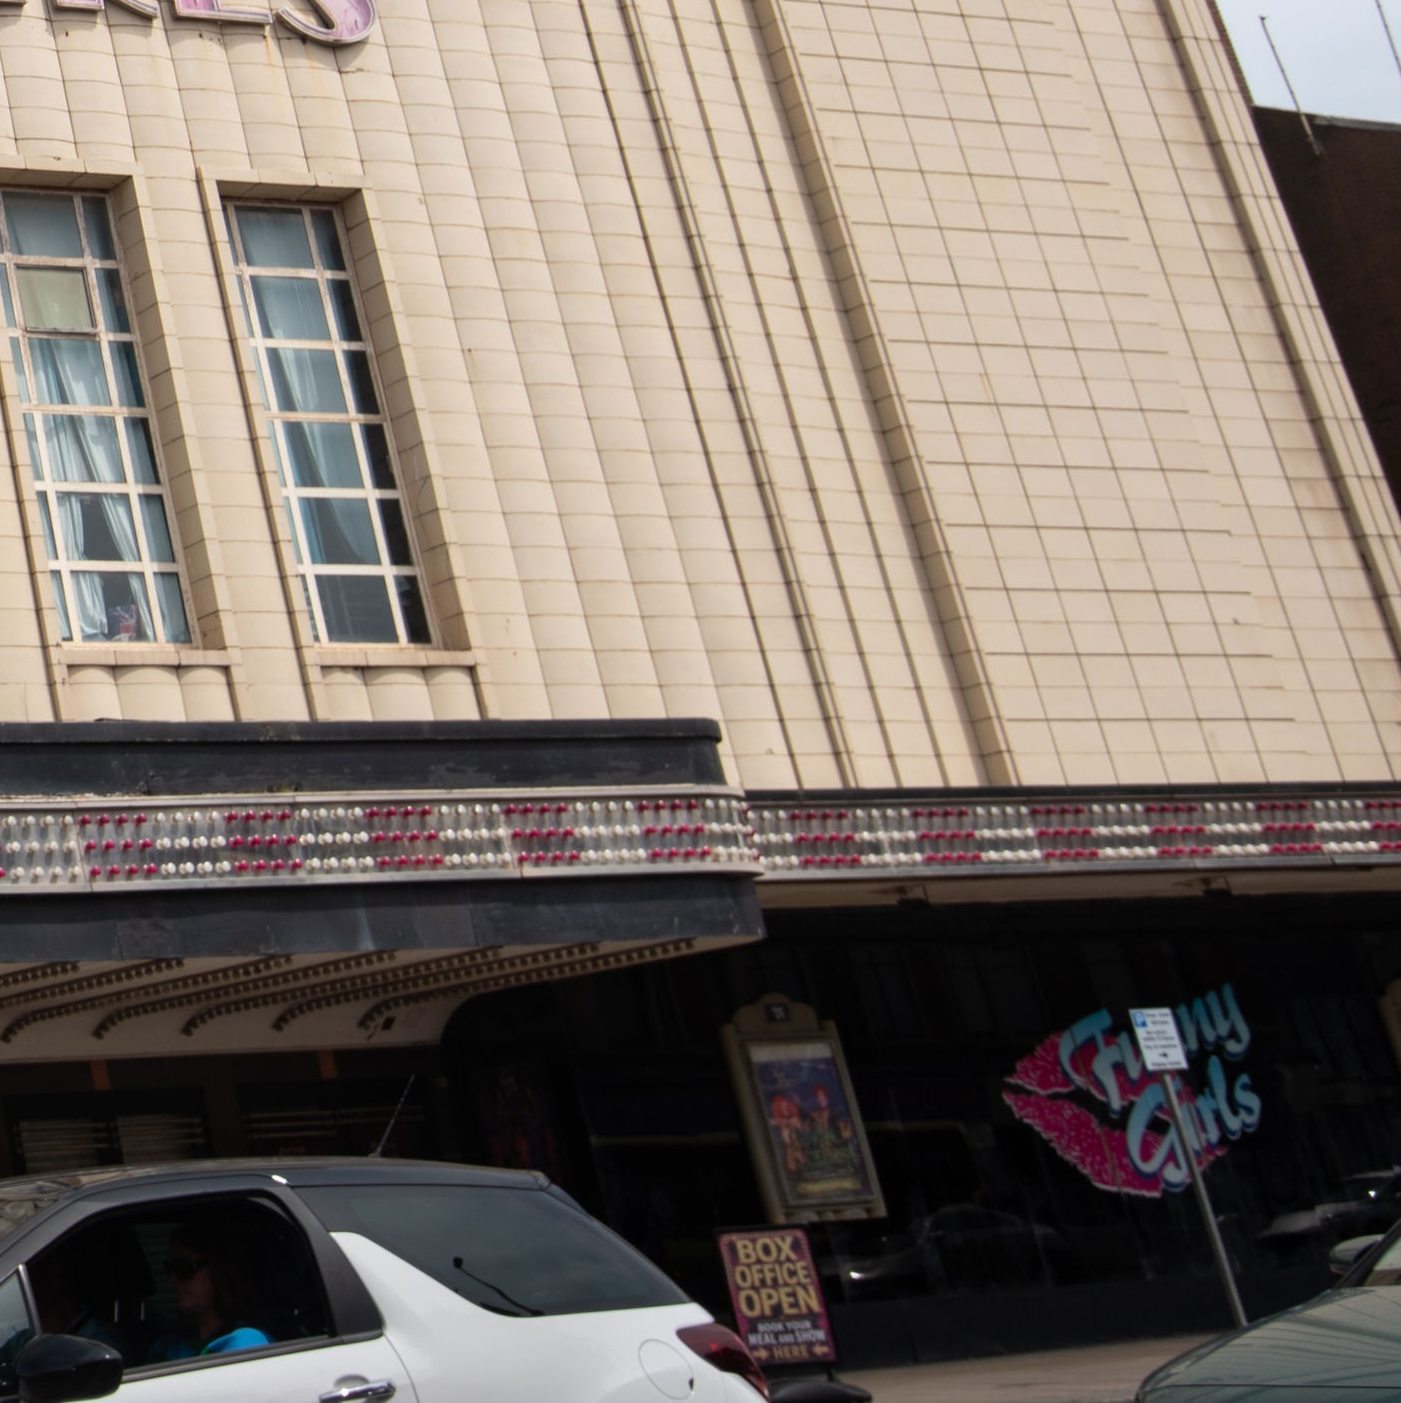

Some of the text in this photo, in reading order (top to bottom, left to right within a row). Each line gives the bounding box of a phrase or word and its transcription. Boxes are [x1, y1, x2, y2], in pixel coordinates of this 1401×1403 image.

[1058, 982, 1251, 1119] Funy
[735, 1236, 798, 1264] BOX
[735, 1262, 812, 1289] OFFICE
[738, 1285, 821, 1318] OPEN
[748, 1333, 777, 1345] MEAL
[795, 1329, 826, 1342] SHOW
[757, 1319, 812, 1332] BOOK YOUR
[771, 1345, 809, 1360] HERE
